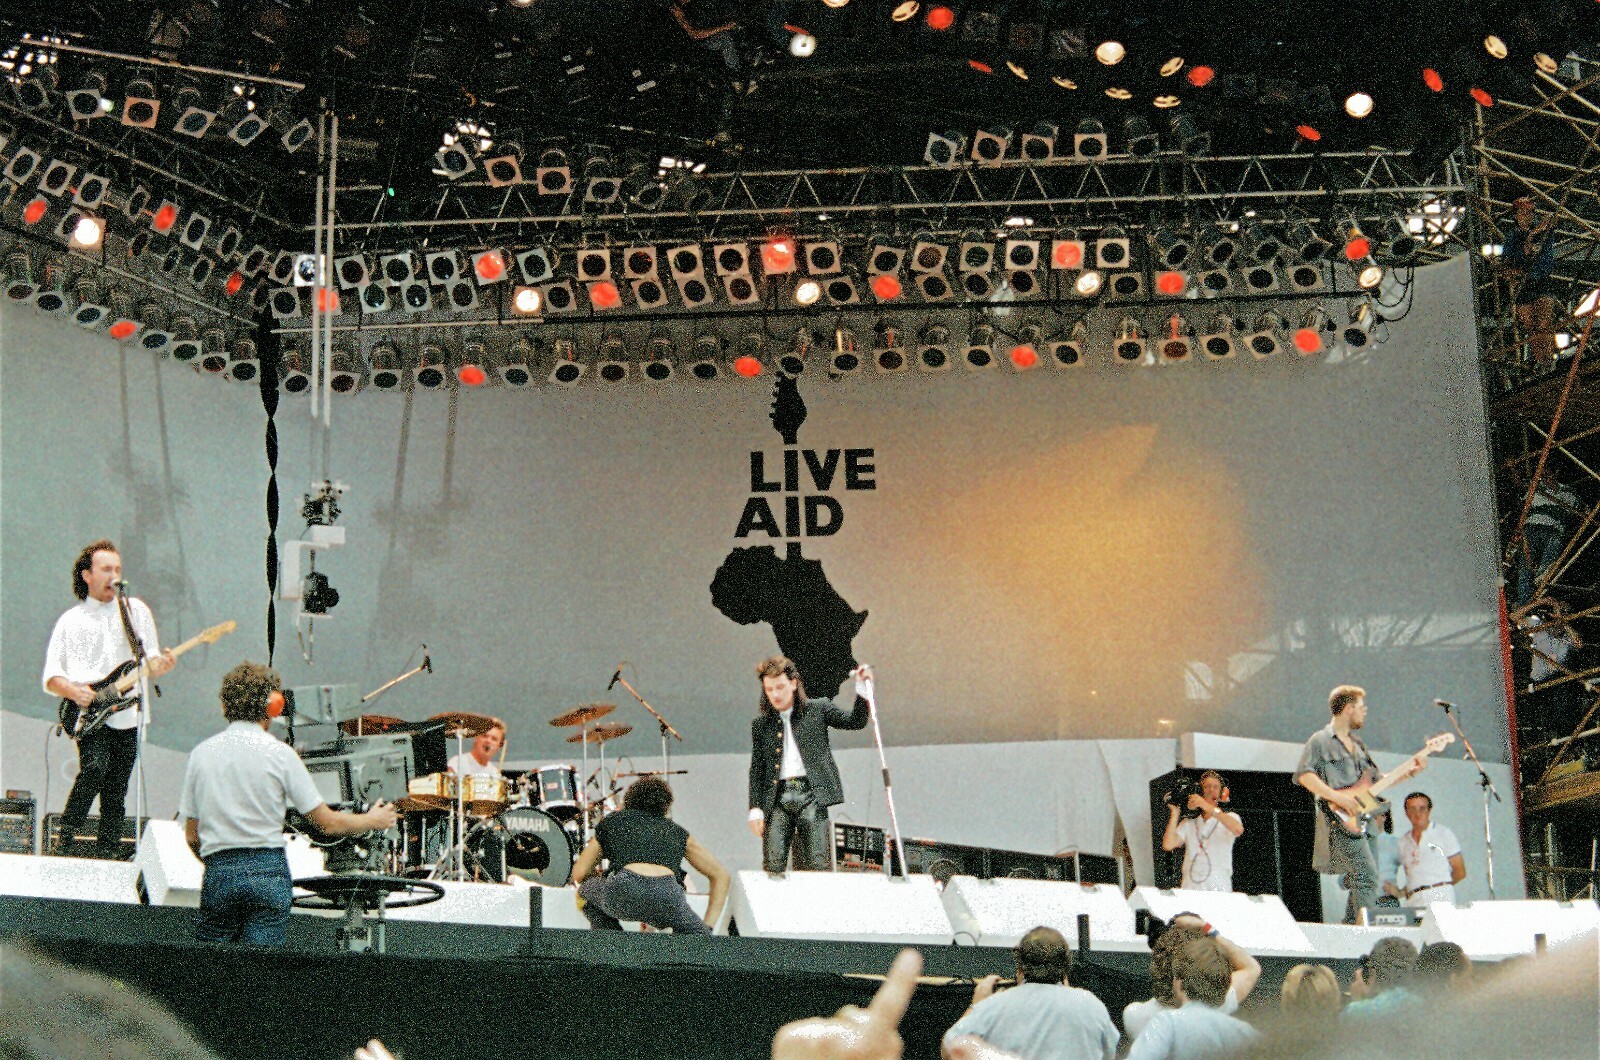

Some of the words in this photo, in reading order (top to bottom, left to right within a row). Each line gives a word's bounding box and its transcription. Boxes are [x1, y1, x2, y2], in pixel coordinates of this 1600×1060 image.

[750, 448, 876, 492] LIVE
[734, 495, 844, 538] AID
[505, 816, 550, 832] YAMAHA
